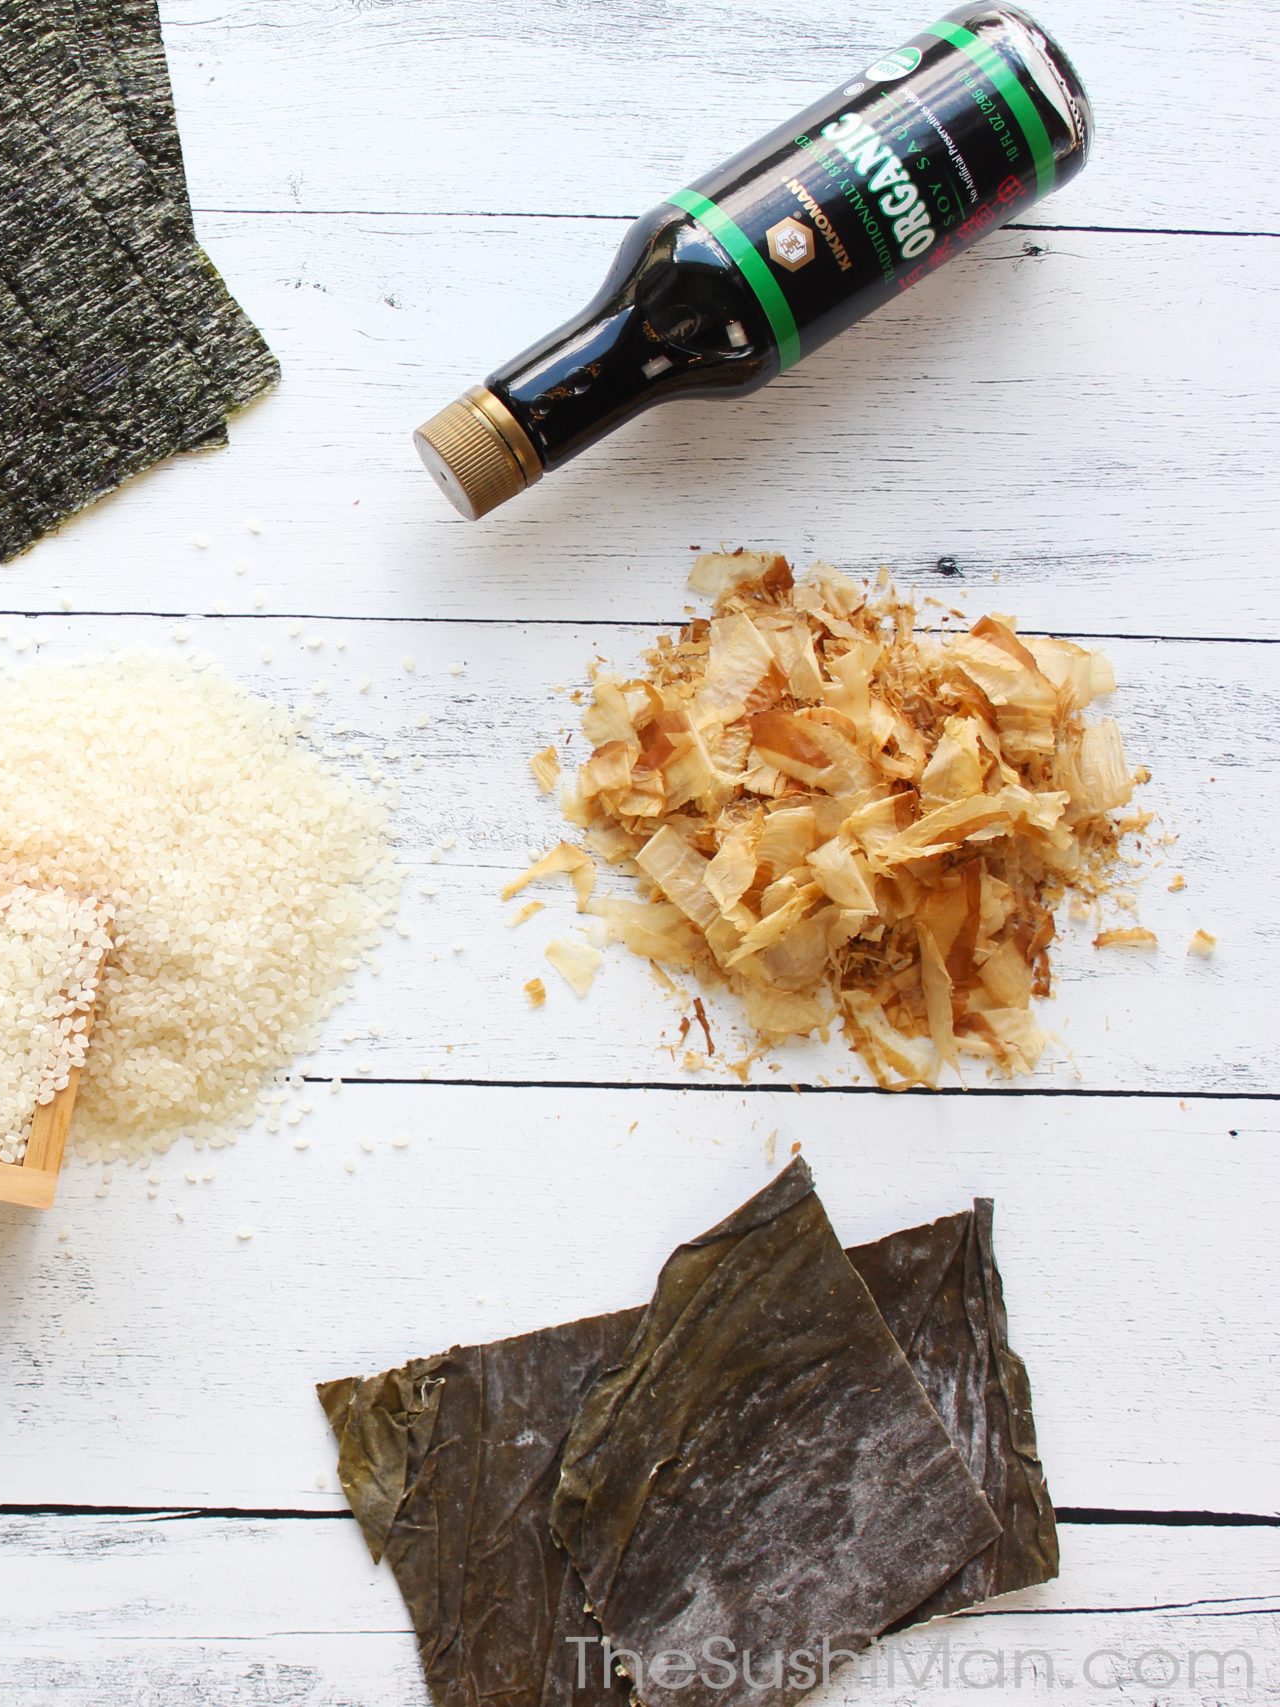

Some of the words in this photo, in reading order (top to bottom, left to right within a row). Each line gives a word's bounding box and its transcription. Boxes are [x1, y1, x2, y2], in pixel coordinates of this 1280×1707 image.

[900, 86, 923, 107] Added
[971, 88, 997, 115] (296
[868, 102, 930, 170] SAUCE
[920, 105, 959, 155] Preservatives
[988, 113, 1005, 132] OZ
[999, 130, 1015, 148] FL
[795, 135, 842, 178] BREWED
[951, 154, 975, 190] Artificial
[1006, 146, 1020, 162] 10
[821, 112, 936, 259] ORGANIC
[929, 183, 956, 227] SOY
[969, 186, 979, 203] No
[785, 179, 852, 272] KIKKOMAN
[837, 178, 896, 284] TRADITIONALLY
